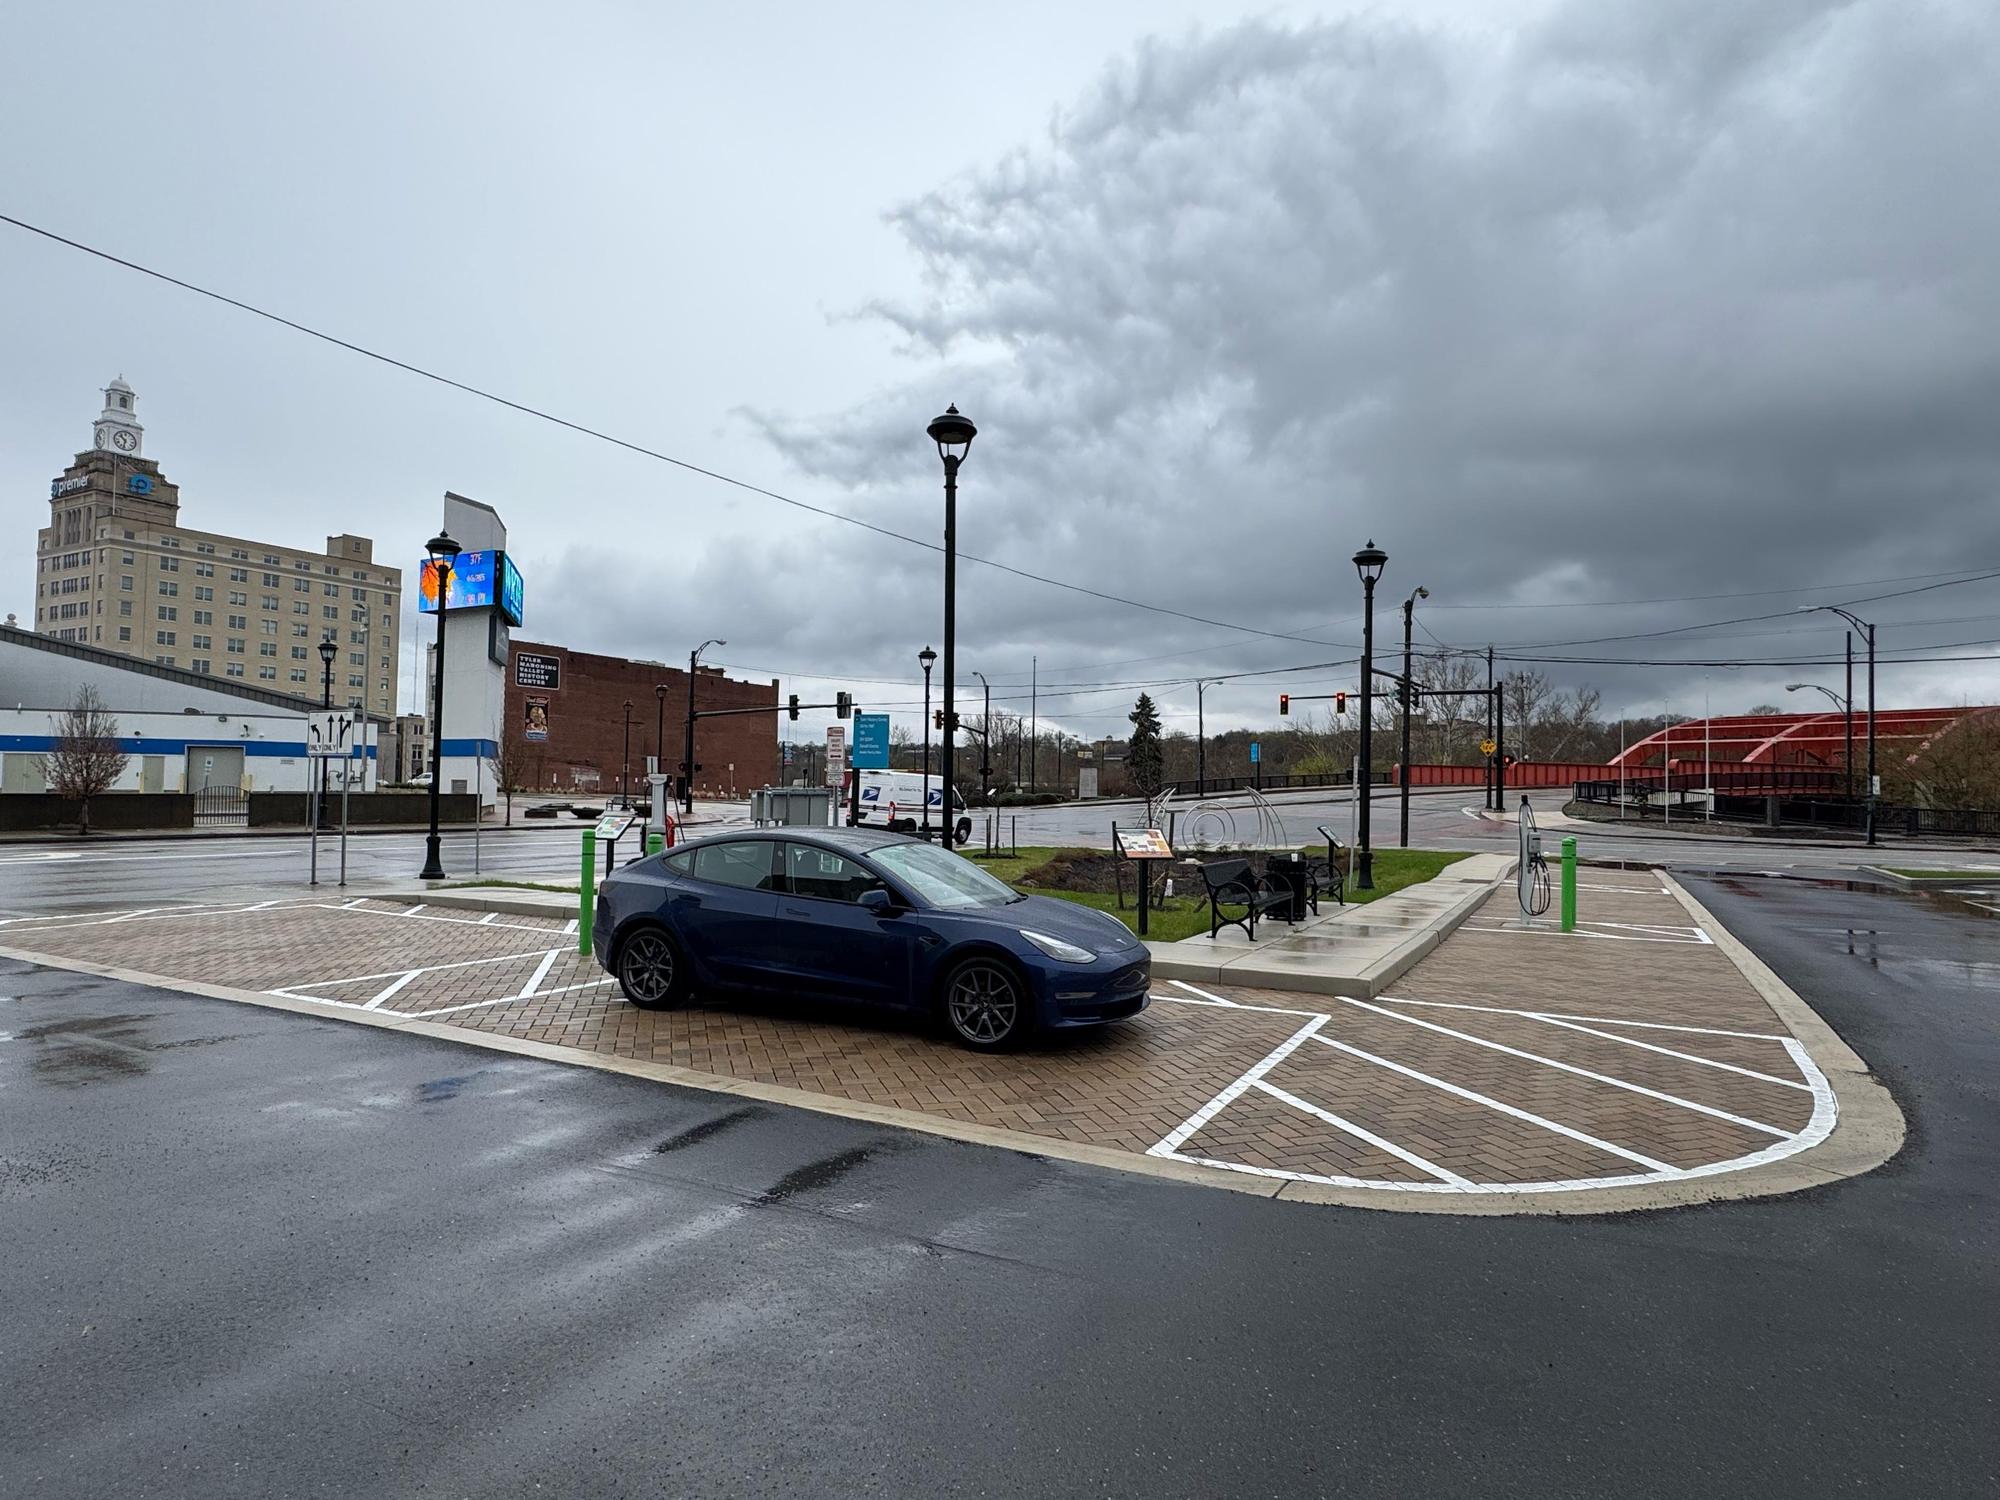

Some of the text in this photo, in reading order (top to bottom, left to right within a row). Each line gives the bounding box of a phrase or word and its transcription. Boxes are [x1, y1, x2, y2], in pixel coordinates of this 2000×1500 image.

[58, 474, 90, 496] premier
[519, 661, 557, 671] MAHONING
[519, 672, 549, 680] HISTORY
